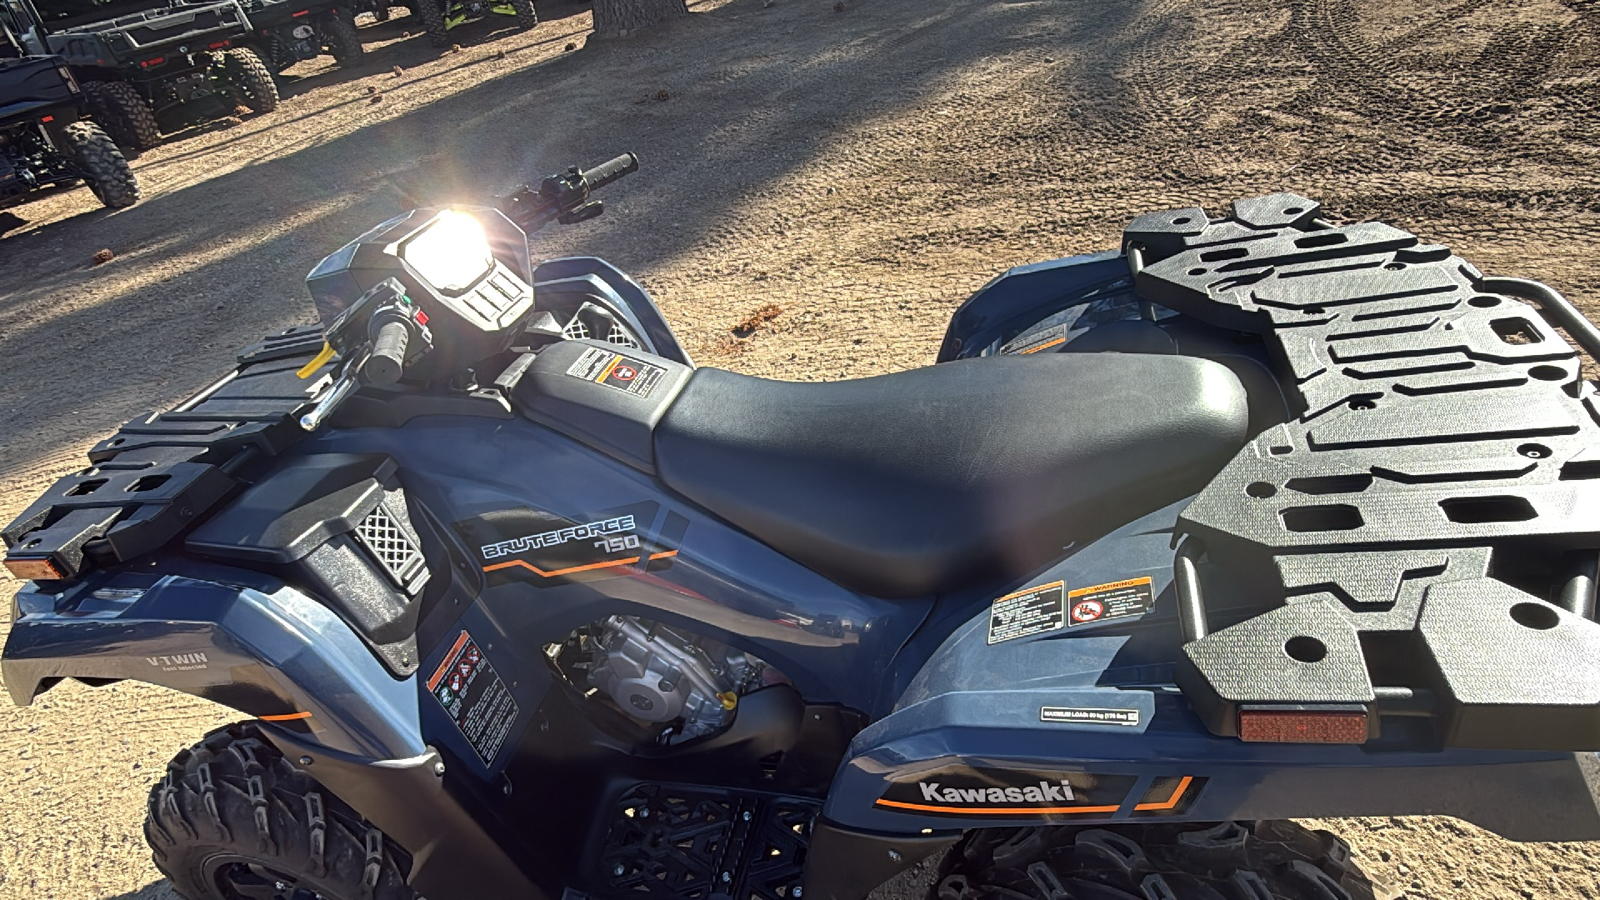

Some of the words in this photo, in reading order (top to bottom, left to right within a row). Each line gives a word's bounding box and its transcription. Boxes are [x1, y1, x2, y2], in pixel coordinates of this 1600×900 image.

[482, 532, 558, 559] BRUTE
[558, 514, 636, 542] FORCE
[594, 534, 640, 554] 750
[145, 653, 208, 666] V-TWIN
[919, 779, 1075, 804] Kawasaki
